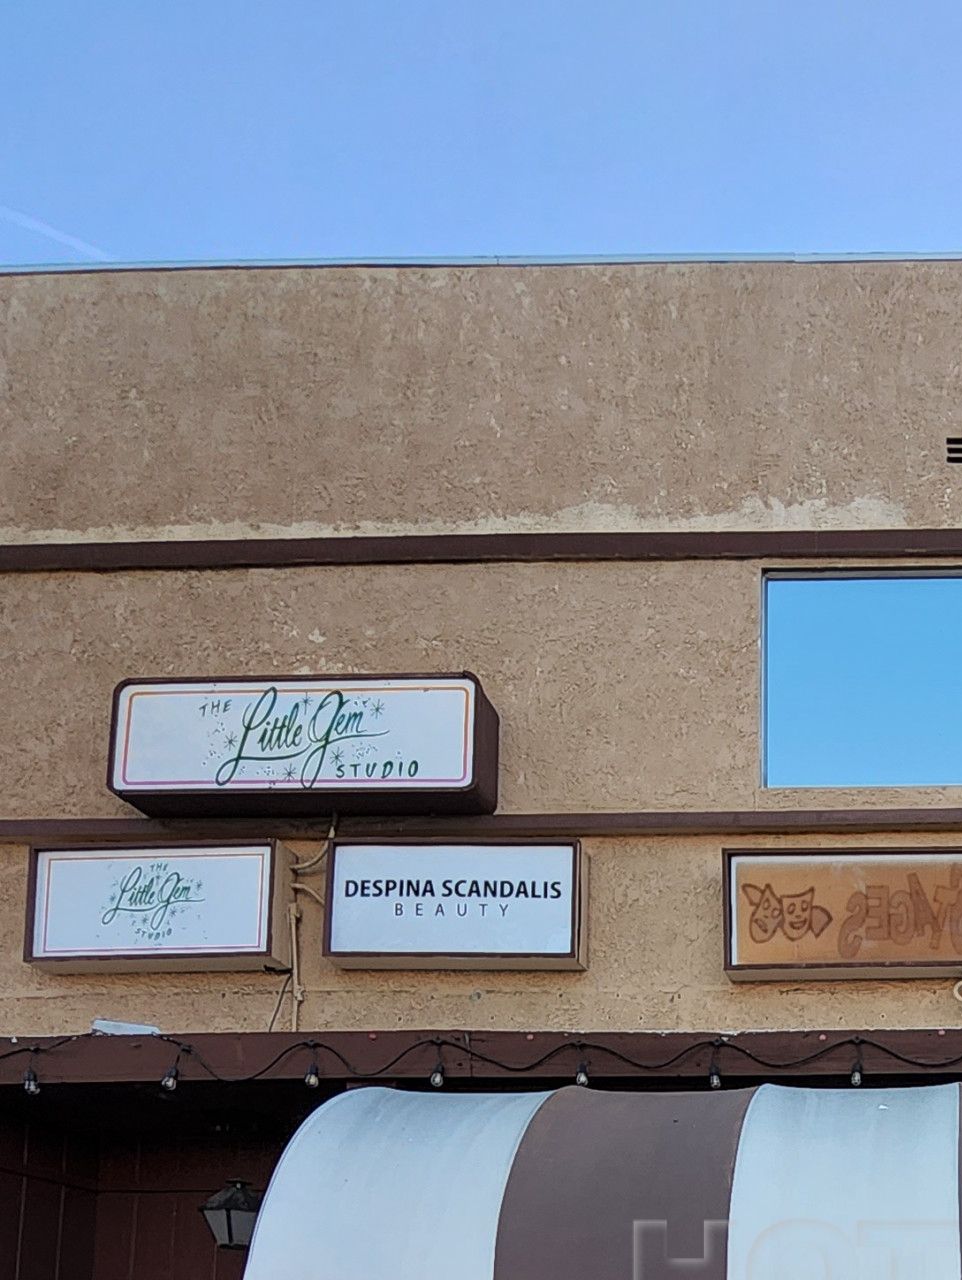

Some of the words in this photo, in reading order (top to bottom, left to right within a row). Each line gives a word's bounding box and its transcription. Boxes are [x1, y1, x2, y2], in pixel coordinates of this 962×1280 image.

[199, 699, 232, 717] THE
[215, 686, 311, 786] Little
[301, 690, 390, 790] Gem
[335, 760, 419, 778] STUDIO
[102, 866, 159, 925] Little
[150, 872, 205, 930] Gem
[344, 879, 436, 898] DESPINA
[441, 879, 562, 899] SCANDALIS
[394, 903, 510, 917] BEAUTY
[135, 928, 172, 941] STUDIO
